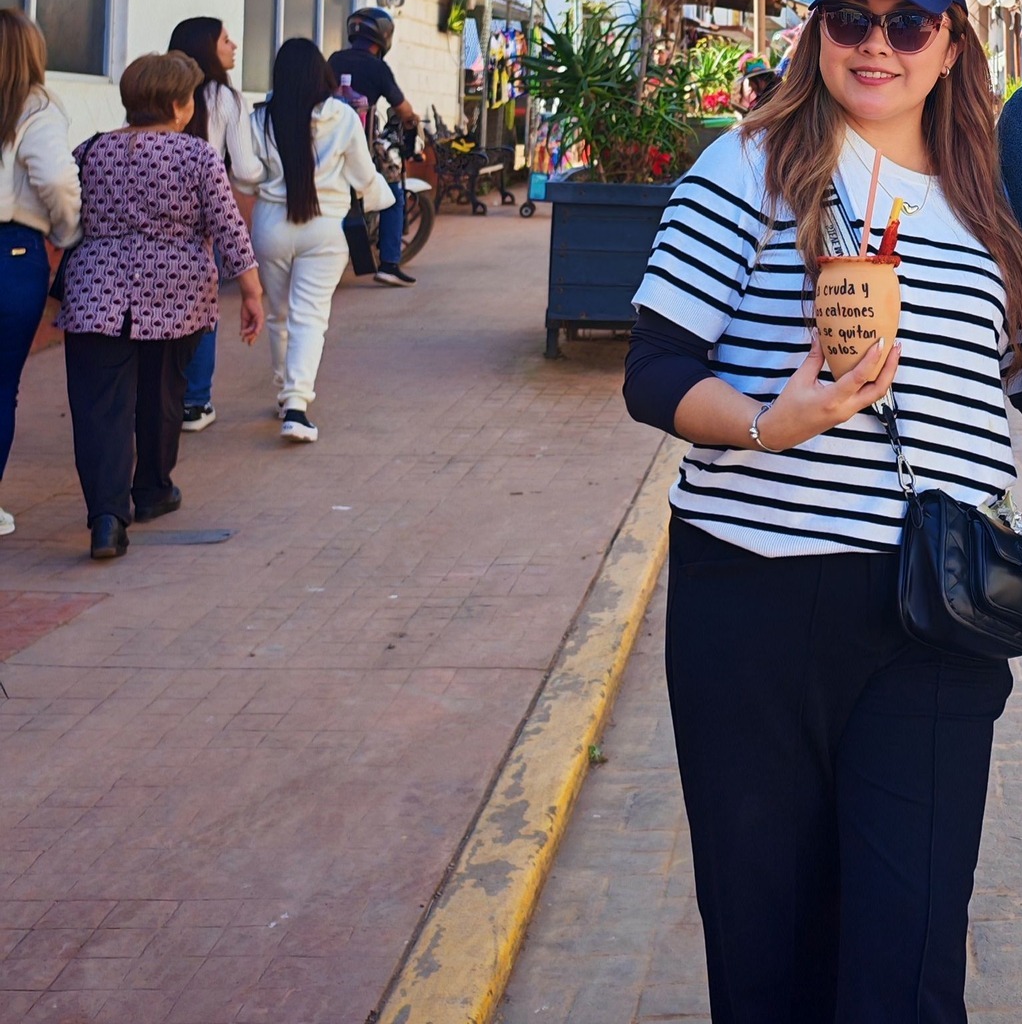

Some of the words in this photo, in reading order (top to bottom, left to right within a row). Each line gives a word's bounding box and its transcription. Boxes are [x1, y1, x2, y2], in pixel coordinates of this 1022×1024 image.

[823, 278, 856, 296] cruda
[861, 282, 869, 299] y
[825, 301, 875, 318] calzones
[823, 327, 833, 337] se
[838, 324, 877, 343] quitan
